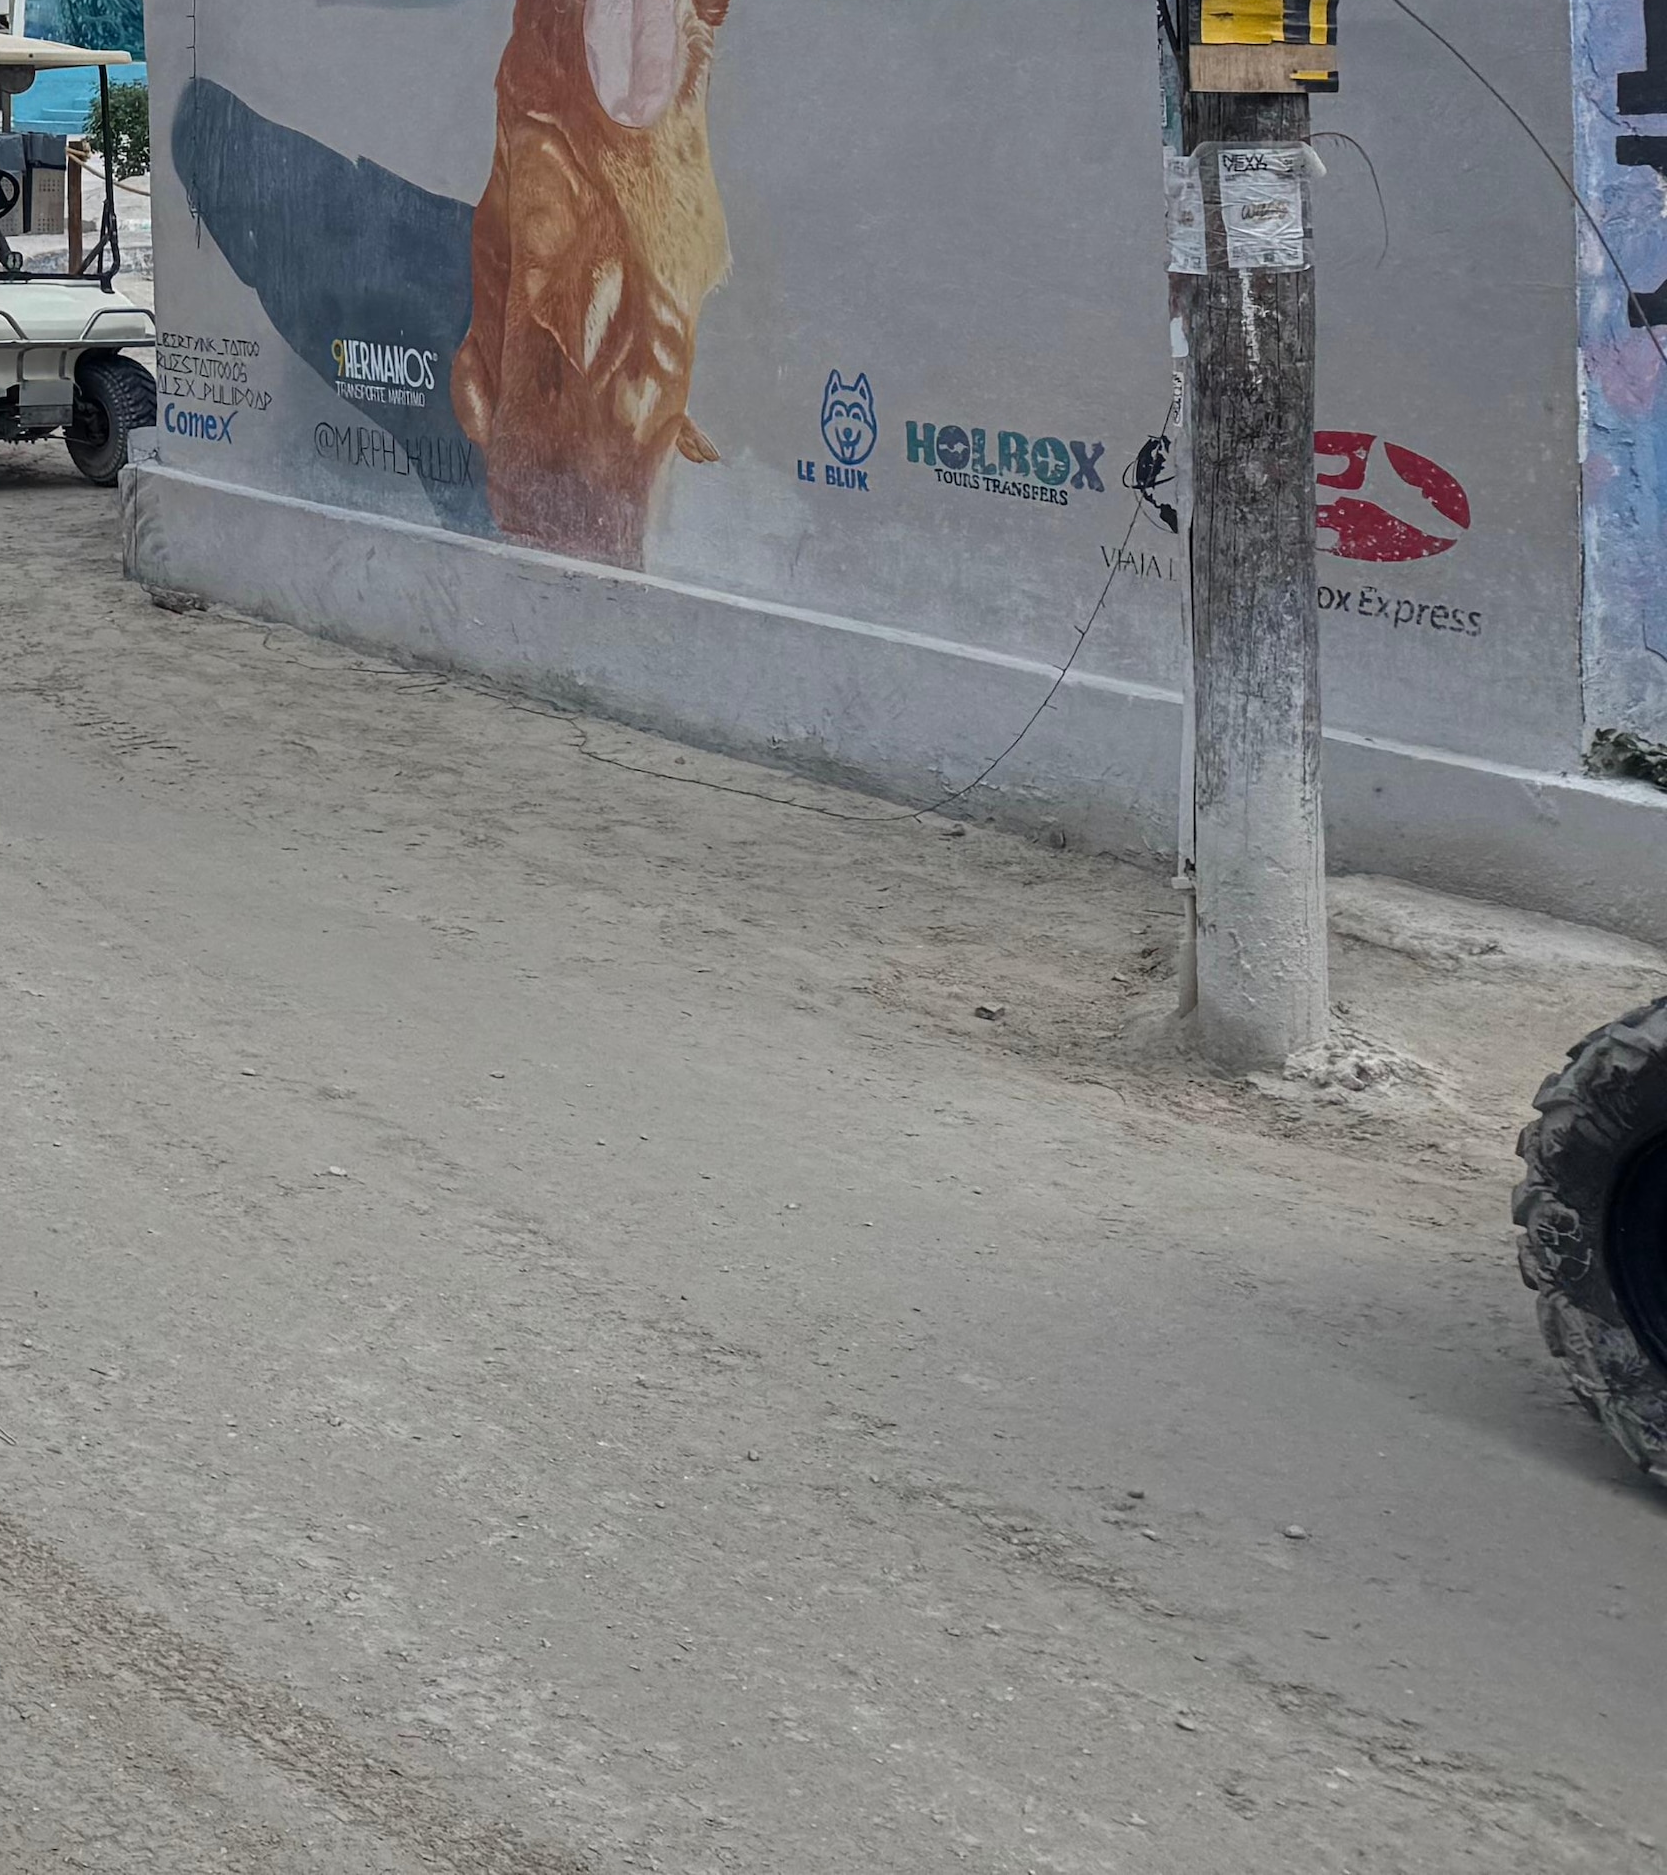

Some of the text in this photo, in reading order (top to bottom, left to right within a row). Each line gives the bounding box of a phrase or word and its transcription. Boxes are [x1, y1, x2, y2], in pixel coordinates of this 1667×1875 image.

[797, 458, 816, 483] LE
[904, 420, 1106, 493] HOLBOX
[934, 467, 1069, 506] TOURS TRANSFERS
[1358, 585, 1482, 637] Express
